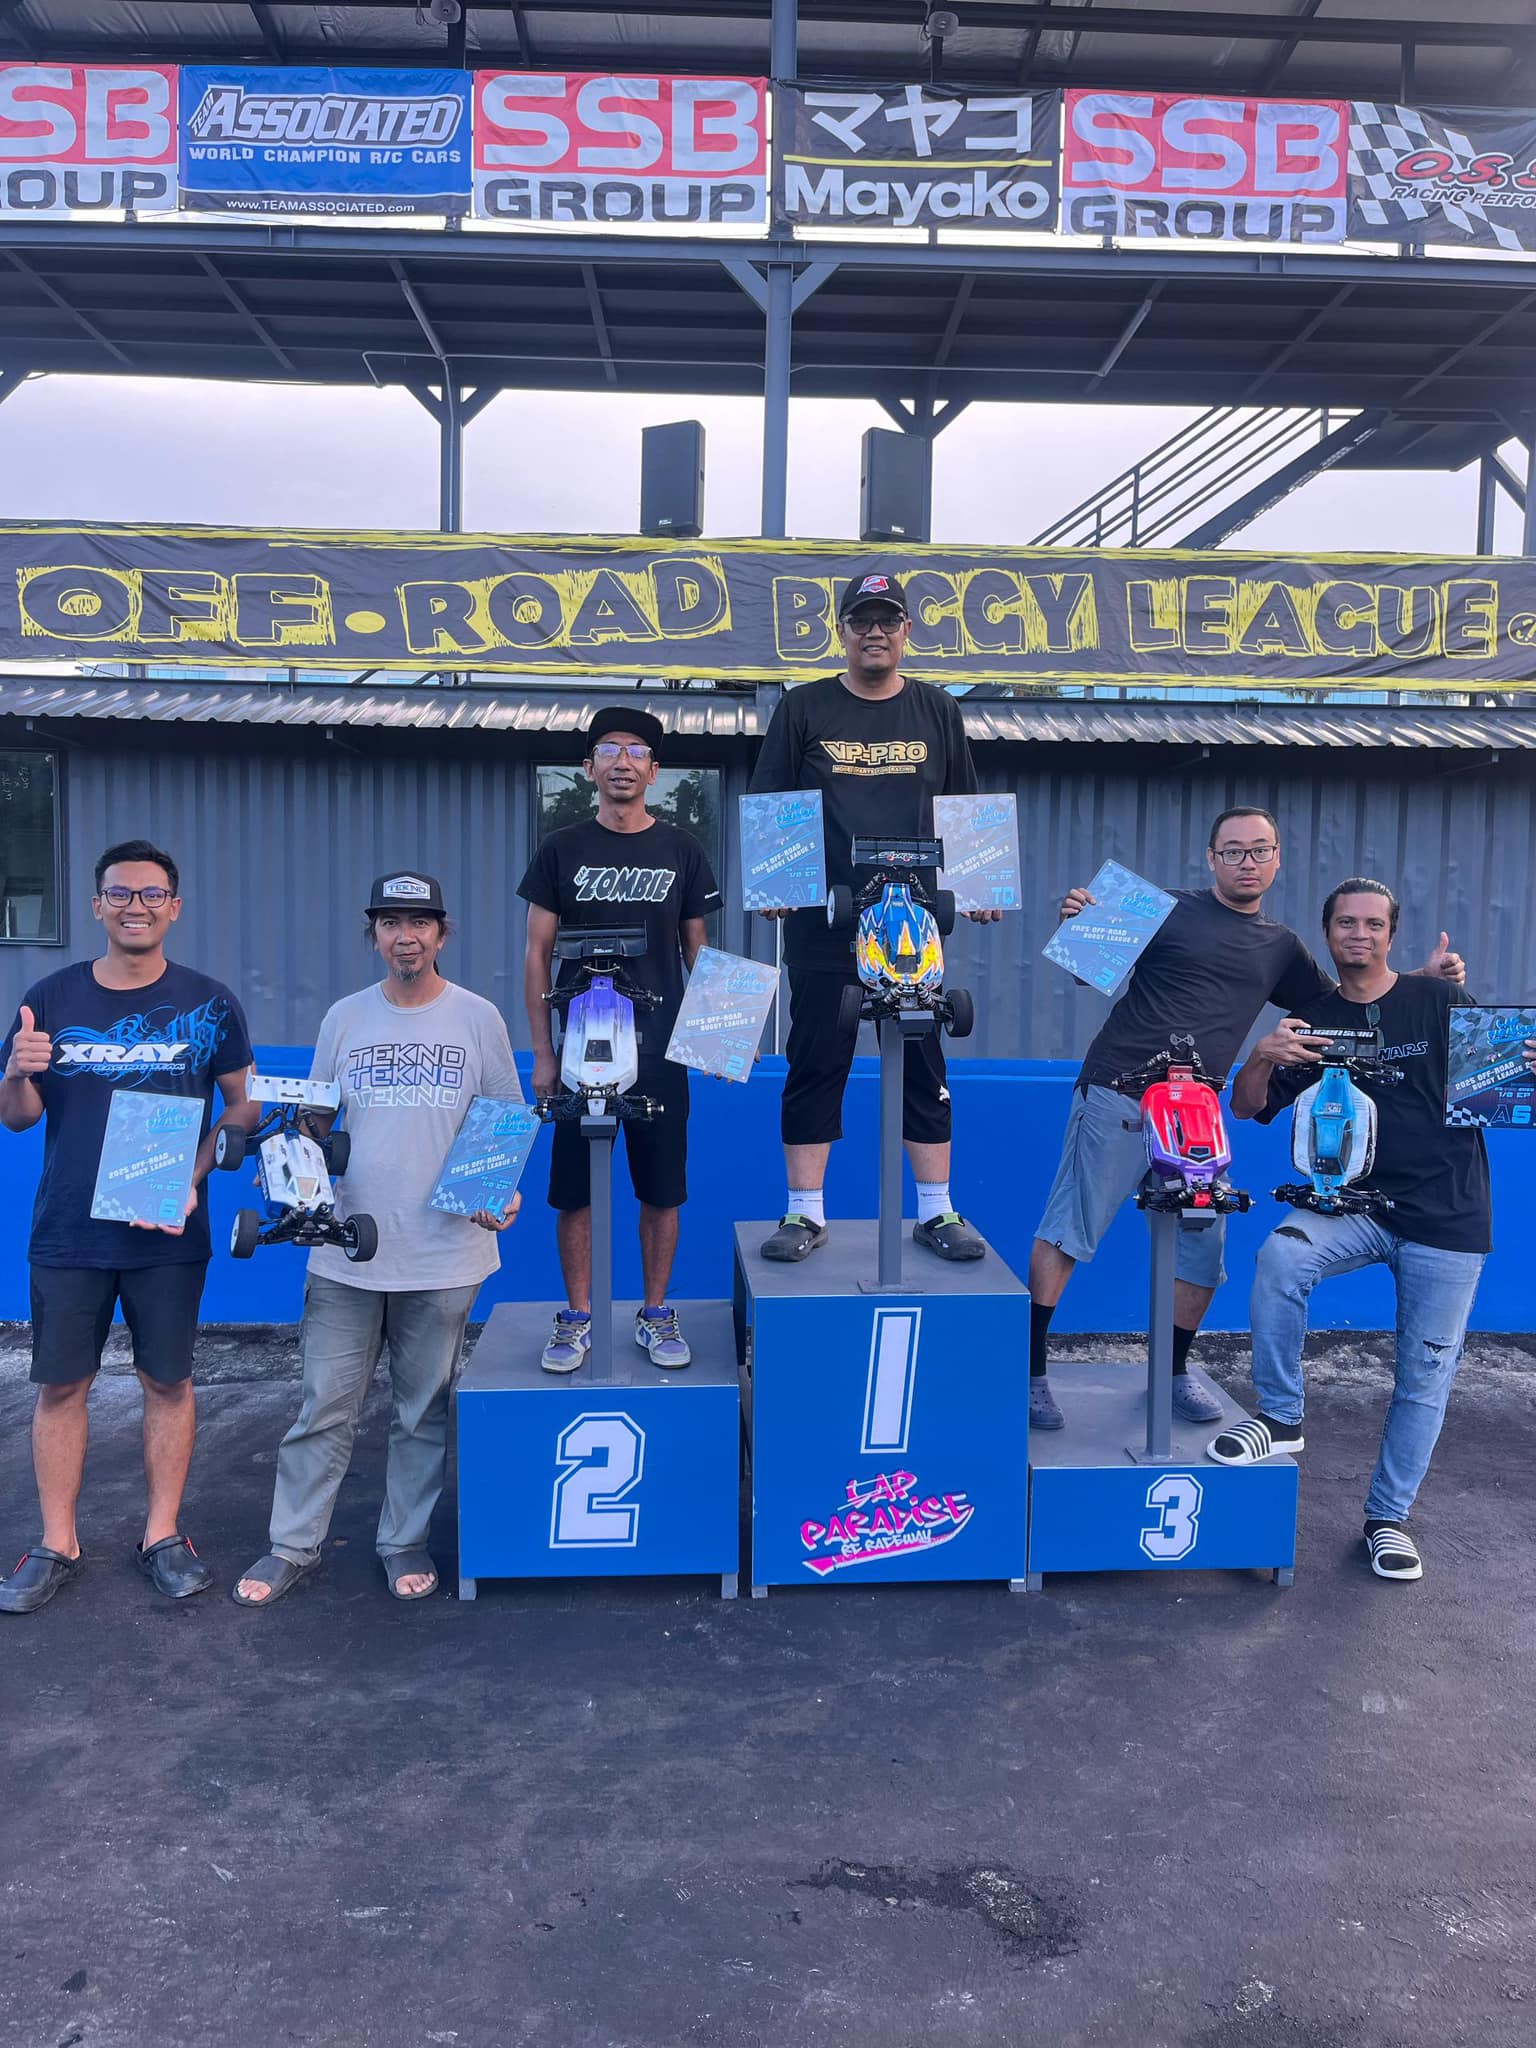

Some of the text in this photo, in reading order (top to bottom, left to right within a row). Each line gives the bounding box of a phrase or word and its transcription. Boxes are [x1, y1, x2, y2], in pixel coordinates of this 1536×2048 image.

[198, 91, 458, 142] ASSOCIATED
[481, 74, 759, 171] SSB
[804, 85, 1033, 157] マヤコ
[189, 147, 461, 164] WORLD CHAMPION R/C CARS
[1071, 94, 1340, 192] SSB
[1394, 148, 1508, 190] O.S.
[226, 200, 415, 213] www.TEAMASSOCIATED.com
[484, 178, 756, 223] GROUP
[784, 164, 1050, 226] Mayako
[1390, 188, 1467, 202] RACING
[1070, 194, 1335, 243] GROUP
[771, 568, 1099, 662] BGGY
[1128, 577, 1499, 661] LEAGUE
[820, 741, 928, 765] VP-PRO
[387, 884, 427, 894] TEKNO
[574, 866, 676, 902] ZOMBIE
[56, 1043, 190, 1064] XRAY
[349, 1043, 465, 1069] TEKNO
[349, 1064, 464, 1089] TEKNO
[1455, 1061, 1515, 1090] 2025 OFF-ROAD
[1497, 1066, 1523, 1081] LEAGUE
[348, 1086, 461, 1110] TEKNO
[1490, 1104, 1531, 1124] A5
[549, 1411, 646, 1549] 2
[845, 1470, 919, 1508] LAP
[1139, 1473, 1204, 1561] 3
